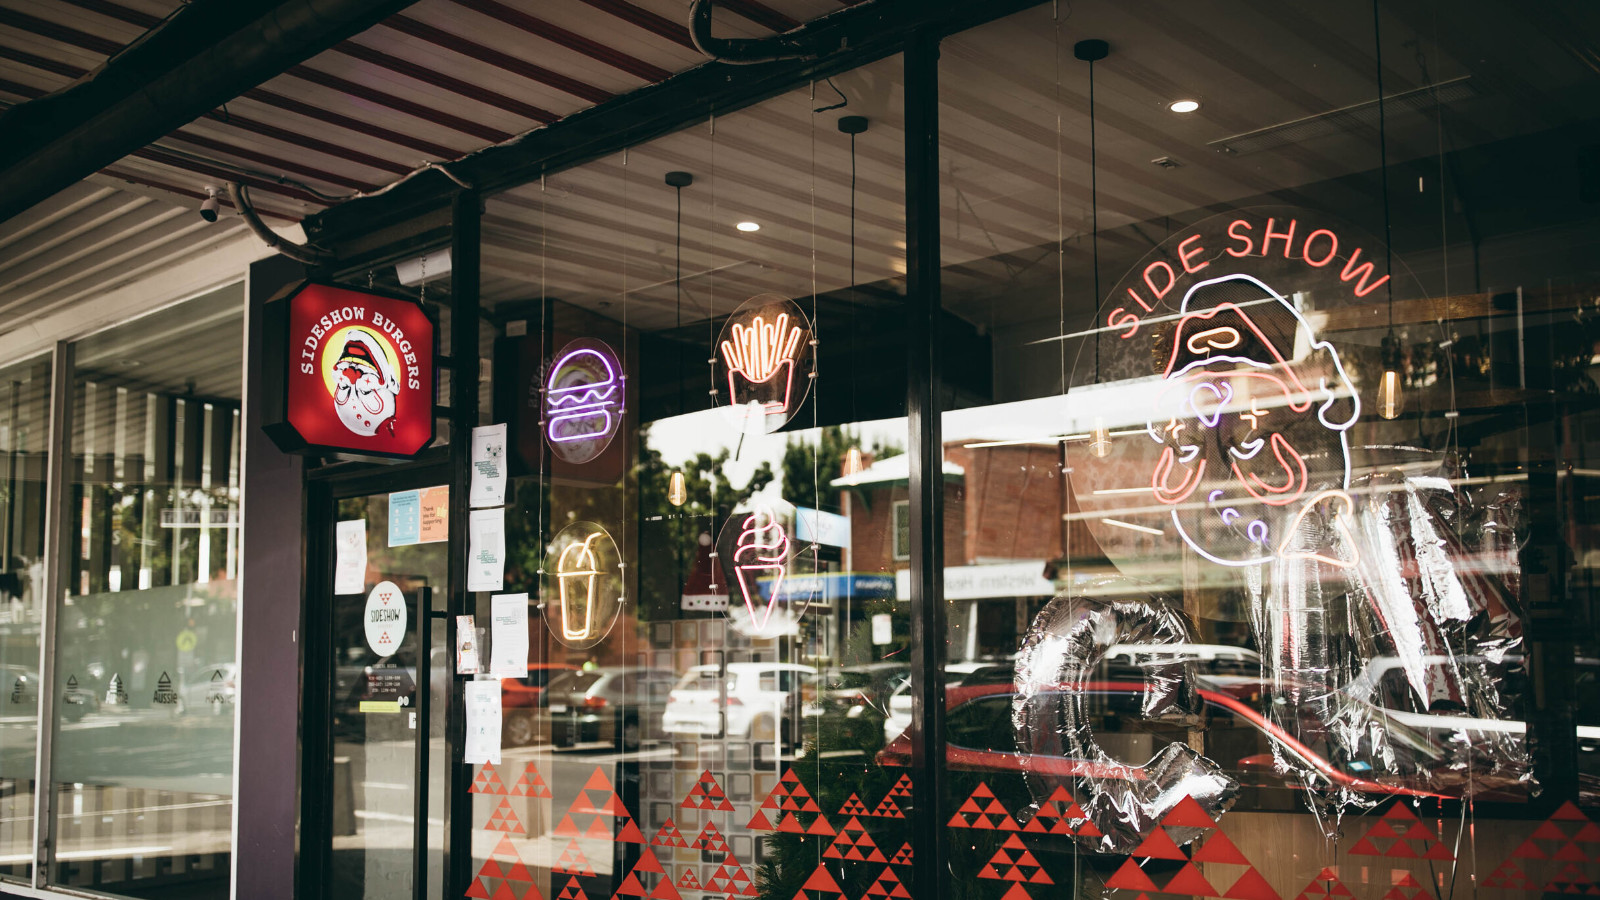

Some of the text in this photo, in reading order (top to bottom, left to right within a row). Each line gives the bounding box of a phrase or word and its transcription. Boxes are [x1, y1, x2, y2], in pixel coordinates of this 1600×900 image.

[1107, 217, 1391, 339] SIDE SHOW
[300, 306, 420, 391] SIDESHOW BURGERS
[370, 608, 401, 623] SIDESHOW
[153, 690, 178, 704] Aussie
